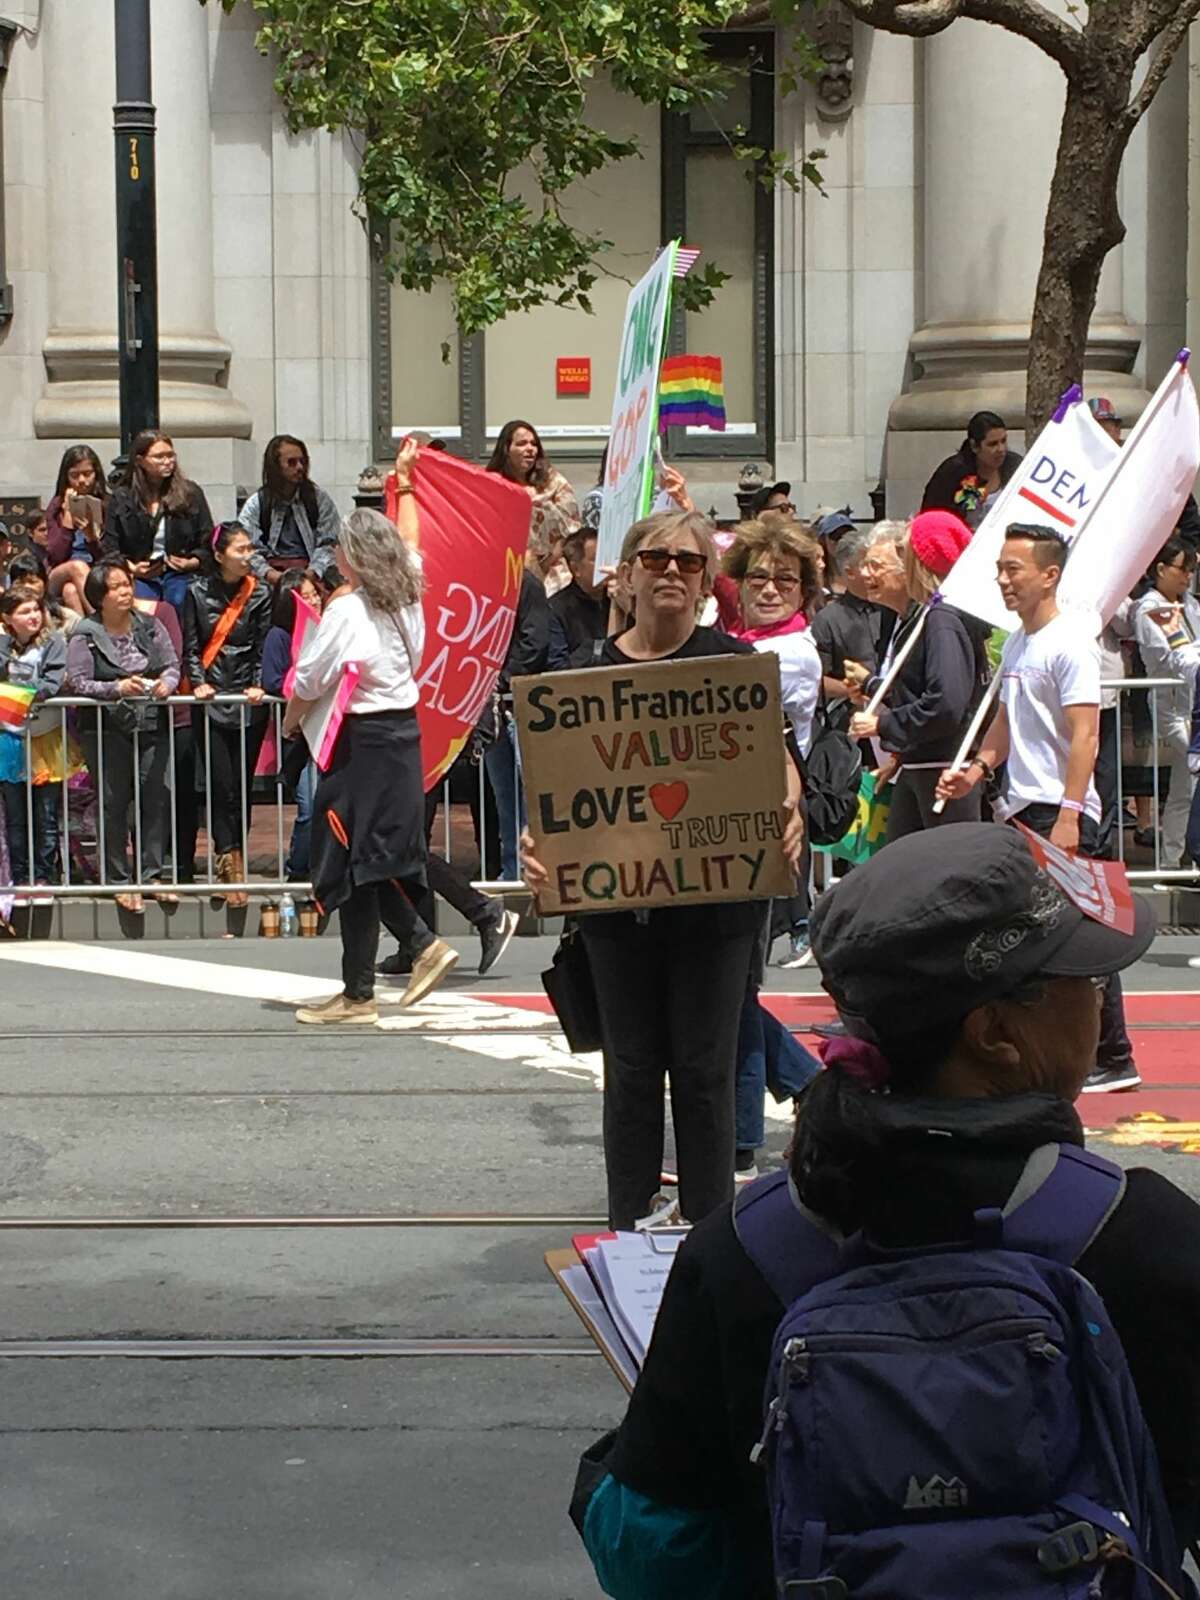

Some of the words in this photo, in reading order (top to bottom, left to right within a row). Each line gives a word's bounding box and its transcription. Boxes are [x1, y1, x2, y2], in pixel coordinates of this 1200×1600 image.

[130, 138, 139, 180] 710
[608, 386, 649, 488] GOP
[527, 685, 605, 733] San
[612, 678, 768, 721] Francisco
[592, 721, 755, 771] VALUES:
[539, 785, 648, 834] LOVE
[661, 810, 784, 849] TRUTH
[557, 848, 766, 904] EQUALITY
